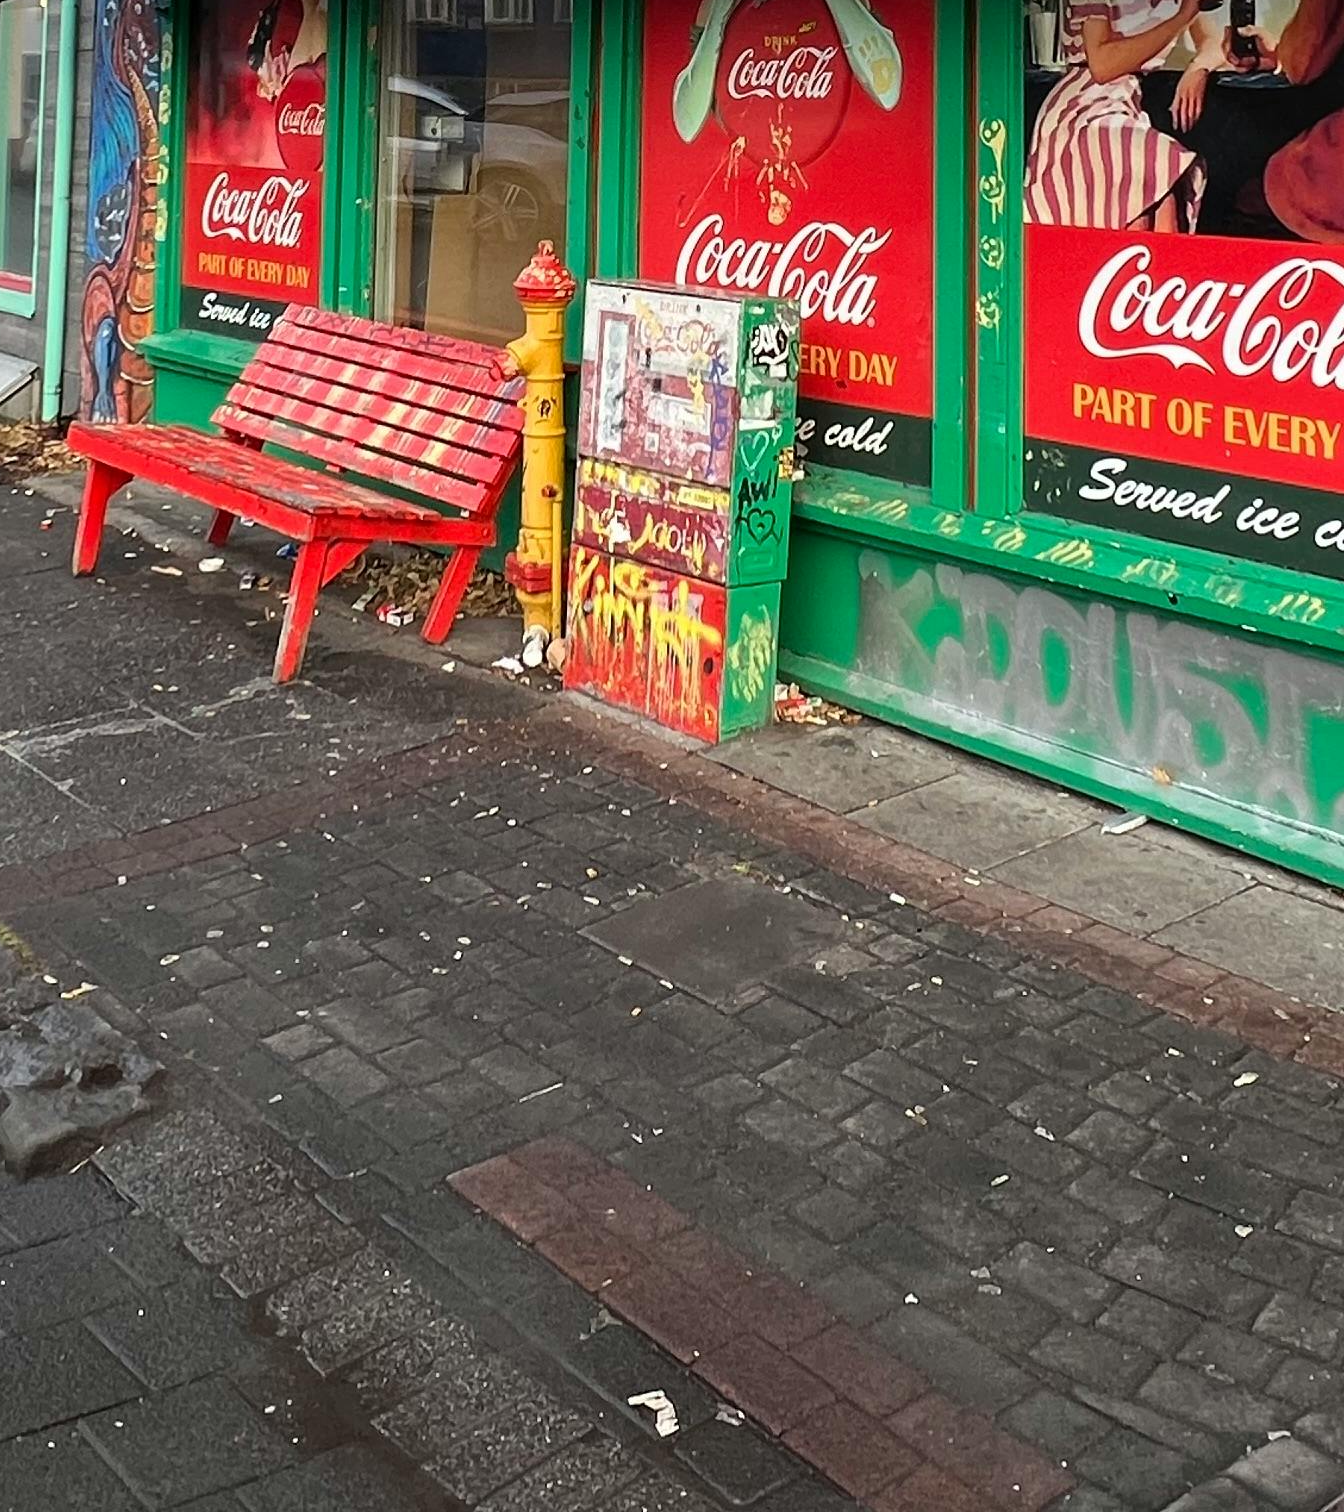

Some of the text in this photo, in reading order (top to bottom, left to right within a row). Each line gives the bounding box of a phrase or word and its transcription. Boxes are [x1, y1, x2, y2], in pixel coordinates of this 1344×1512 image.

[728, 46, 839, 100] Coca-Cola
[201, 171, 311, 248] Coca-Cola
[198, 251, 312, 289] PART OF EVERY DAY
[676, 213, 893, 327] Coca-Cola
[198, 291, 272, 330] Served ice
[798, 342, 843, 380] ERY
[848, 349, 898, 387] DAY
[824, 415, 895, 456] cold
[1072, 383, 1158, 430] PART
[1166, 397, 1213, 439] OF
[1224, 404, 1344, 462] EVERY
[1078, 458, 1233, 525] Served
[1236, 498, 1301, 540] ice
